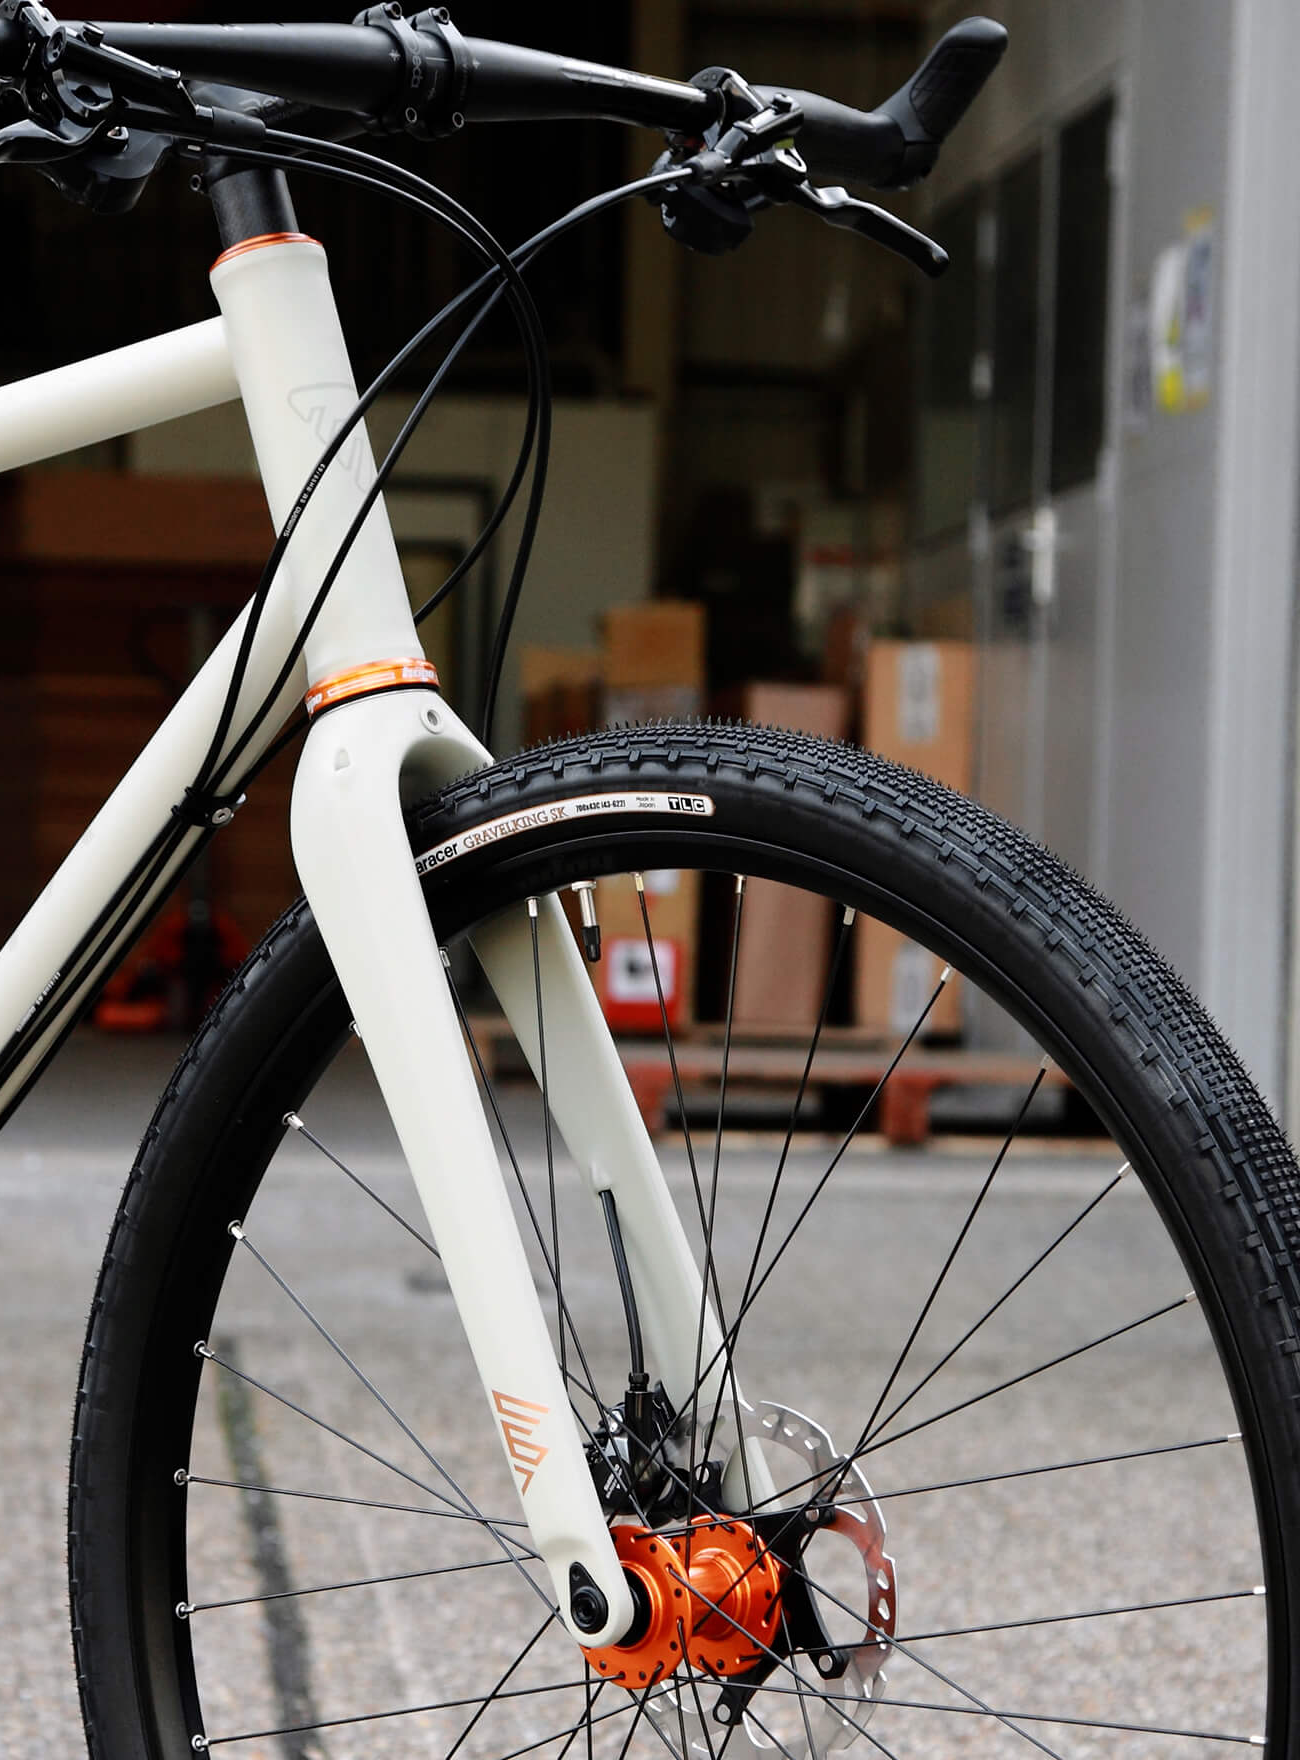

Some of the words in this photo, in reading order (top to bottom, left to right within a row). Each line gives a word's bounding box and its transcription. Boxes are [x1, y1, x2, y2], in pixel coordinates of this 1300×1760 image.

[667, 796, 706, 813] TLC
[463, 811, 549, 848] GRAVELKING
[551, 806, 569, 821] SK
